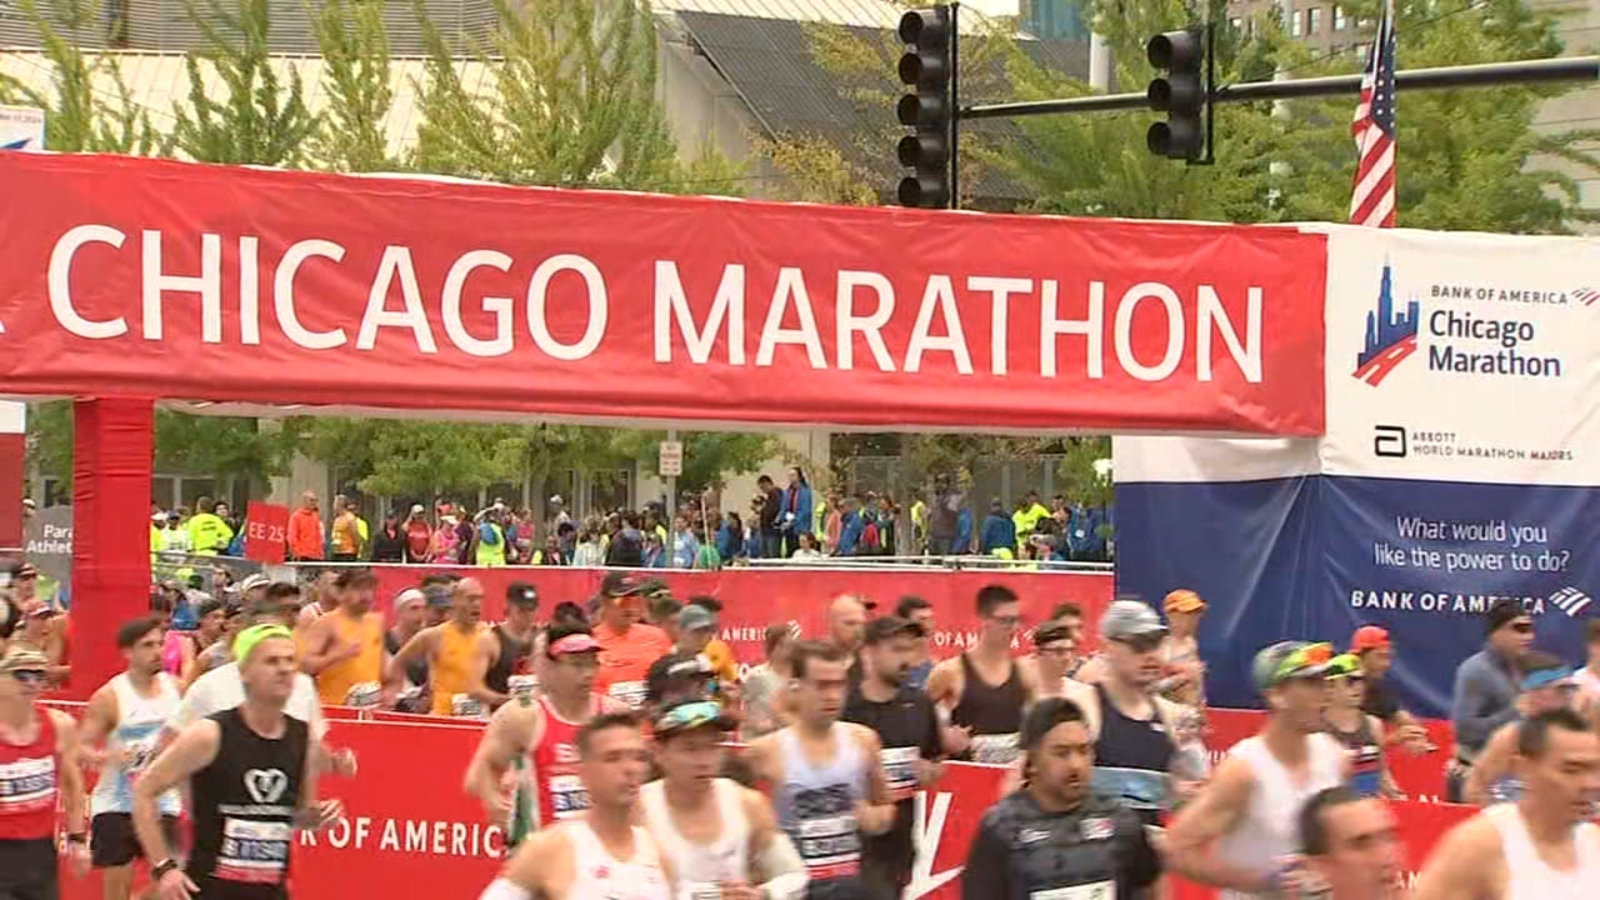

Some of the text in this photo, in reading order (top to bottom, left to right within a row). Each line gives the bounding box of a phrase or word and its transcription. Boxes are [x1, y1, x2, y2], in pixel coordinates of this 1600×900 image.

[48, 224, 1264, 383] CHICAGO MARATHON
[1431, 285, 1568, 304] BANK OF AMERICA
[1430, 310, 1534, 348] Chicago
[1429, 345, 1561, 376] Marathon
[1412, 432, 1456, 443] ABBOTT
[1413, 445, 1573, 461] WORLD MARATHON MAJORS
[249, 521, 284, 542] EE 25
[1397, 516, 1547, 547] What would you
[1374, 542, 1571, 573] like the power to do?
[1351, 590, 1413, 610] BANK
[1420, 594, 1449, 610] OF
[328, 817, 371, 848] OF
[380, 818, 506, 858] AMERIC
